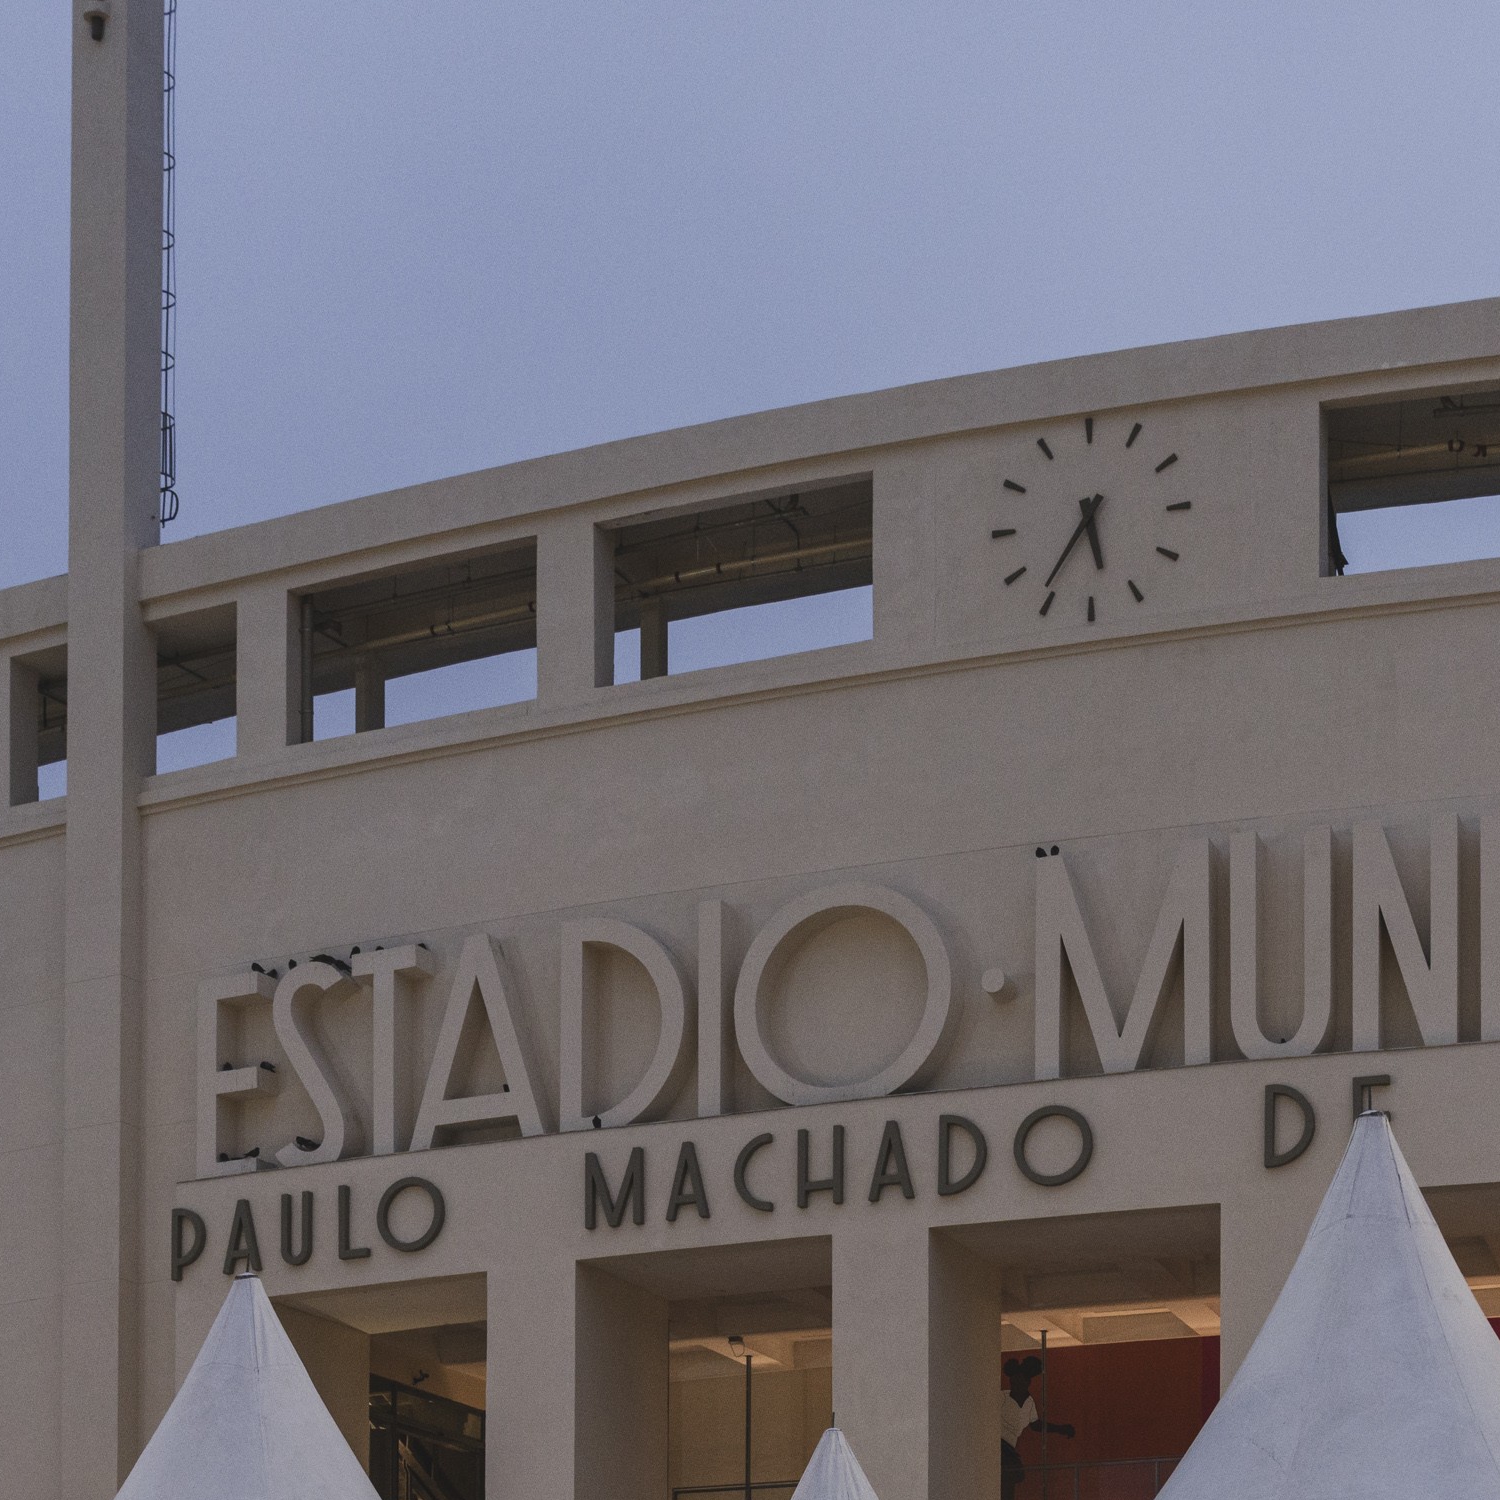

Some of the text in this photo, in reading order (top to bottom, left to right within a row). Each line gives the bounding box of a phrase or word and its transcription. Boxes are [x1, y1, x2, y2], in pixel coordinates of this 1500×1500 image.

[196, 880, 952, 1178] ESTADIO
[170, 1176, 446, 1281] PAULO
[584, 1105, 1094, 1230] MACHADO
